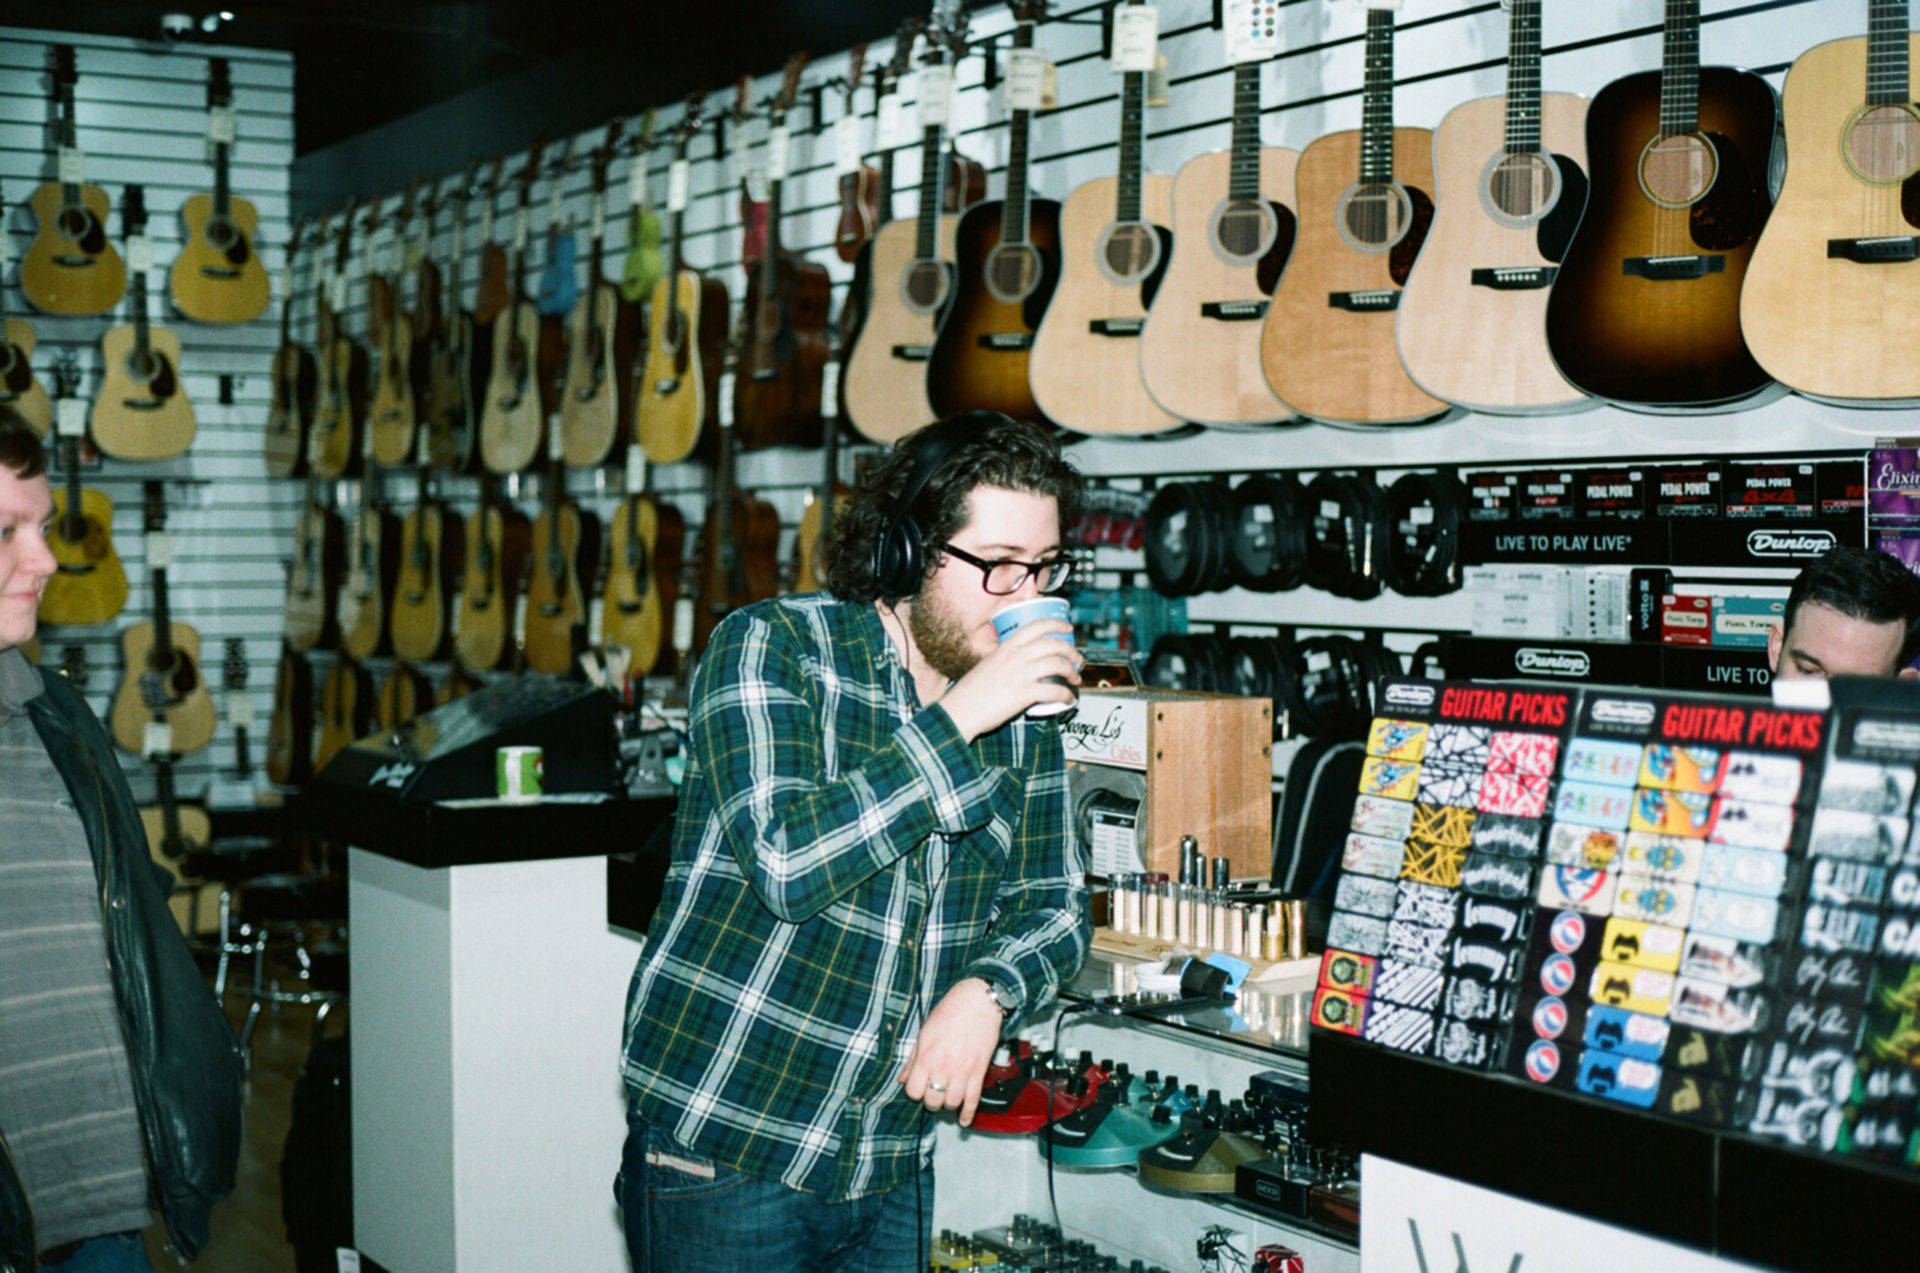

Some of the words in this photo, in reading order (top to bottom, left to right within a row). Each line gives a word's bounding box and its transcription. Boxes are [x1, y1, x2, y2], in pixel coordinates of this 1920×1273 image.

[1660, 482, 1684, 496] PEDAL
[1684, 481, 1711, 496] POWER
[1746, 478, 1767, 488] PEDAL
[1768, 477, 1792, 488] POWER
[1495, 535, 1526, 551] LIVE
[1529, 535, 1550, 551] TO
[1552, 535, 1590, 551] PLAY
[1752, 533, 1833, 555] Dunlop
[1519, 651, 1588, 673] Dunlop
[1707, 665, 1742, 683] LIVE
[1746, 668, 1769, 685] TO
[1440, 687, 1507, 721] GUITAR
[1508, 690, 1569, 727] PICKS
[1661, 702, 1746, 744] GUITAR
[1747, 709, 1824, 750] PICKS
